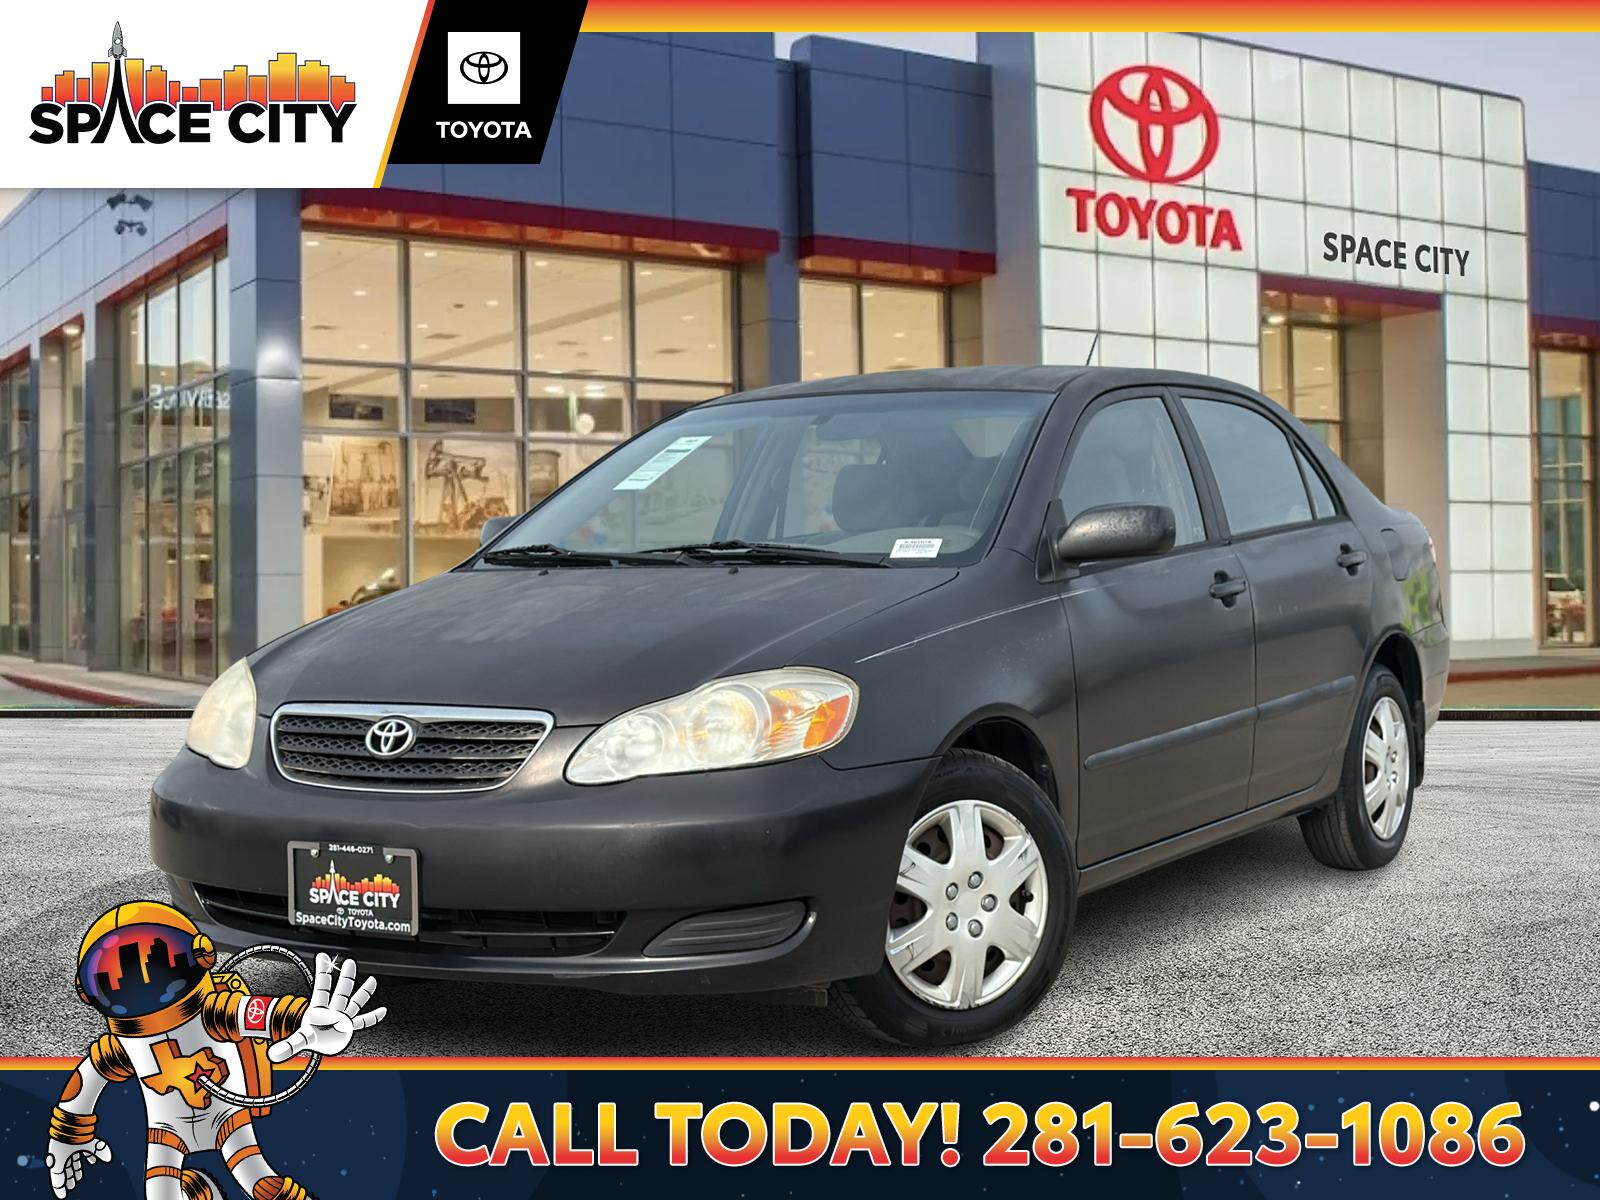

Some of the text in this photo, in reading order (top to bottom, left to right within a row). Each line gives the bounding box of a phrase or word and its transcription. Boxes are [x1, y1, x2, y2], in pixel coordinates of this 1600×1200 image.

[1065, 187, 1242, 251] TOYOTA
[1323, 232, 1470, 277] SPACE CITY
[328, 843, 374, 854] 281-446-0271
[362, 891, 401, 909] CITY
[295, 911, 411, 933] SpaceCityToyota.com
[347, 908, 374, 917] TOYOTA
